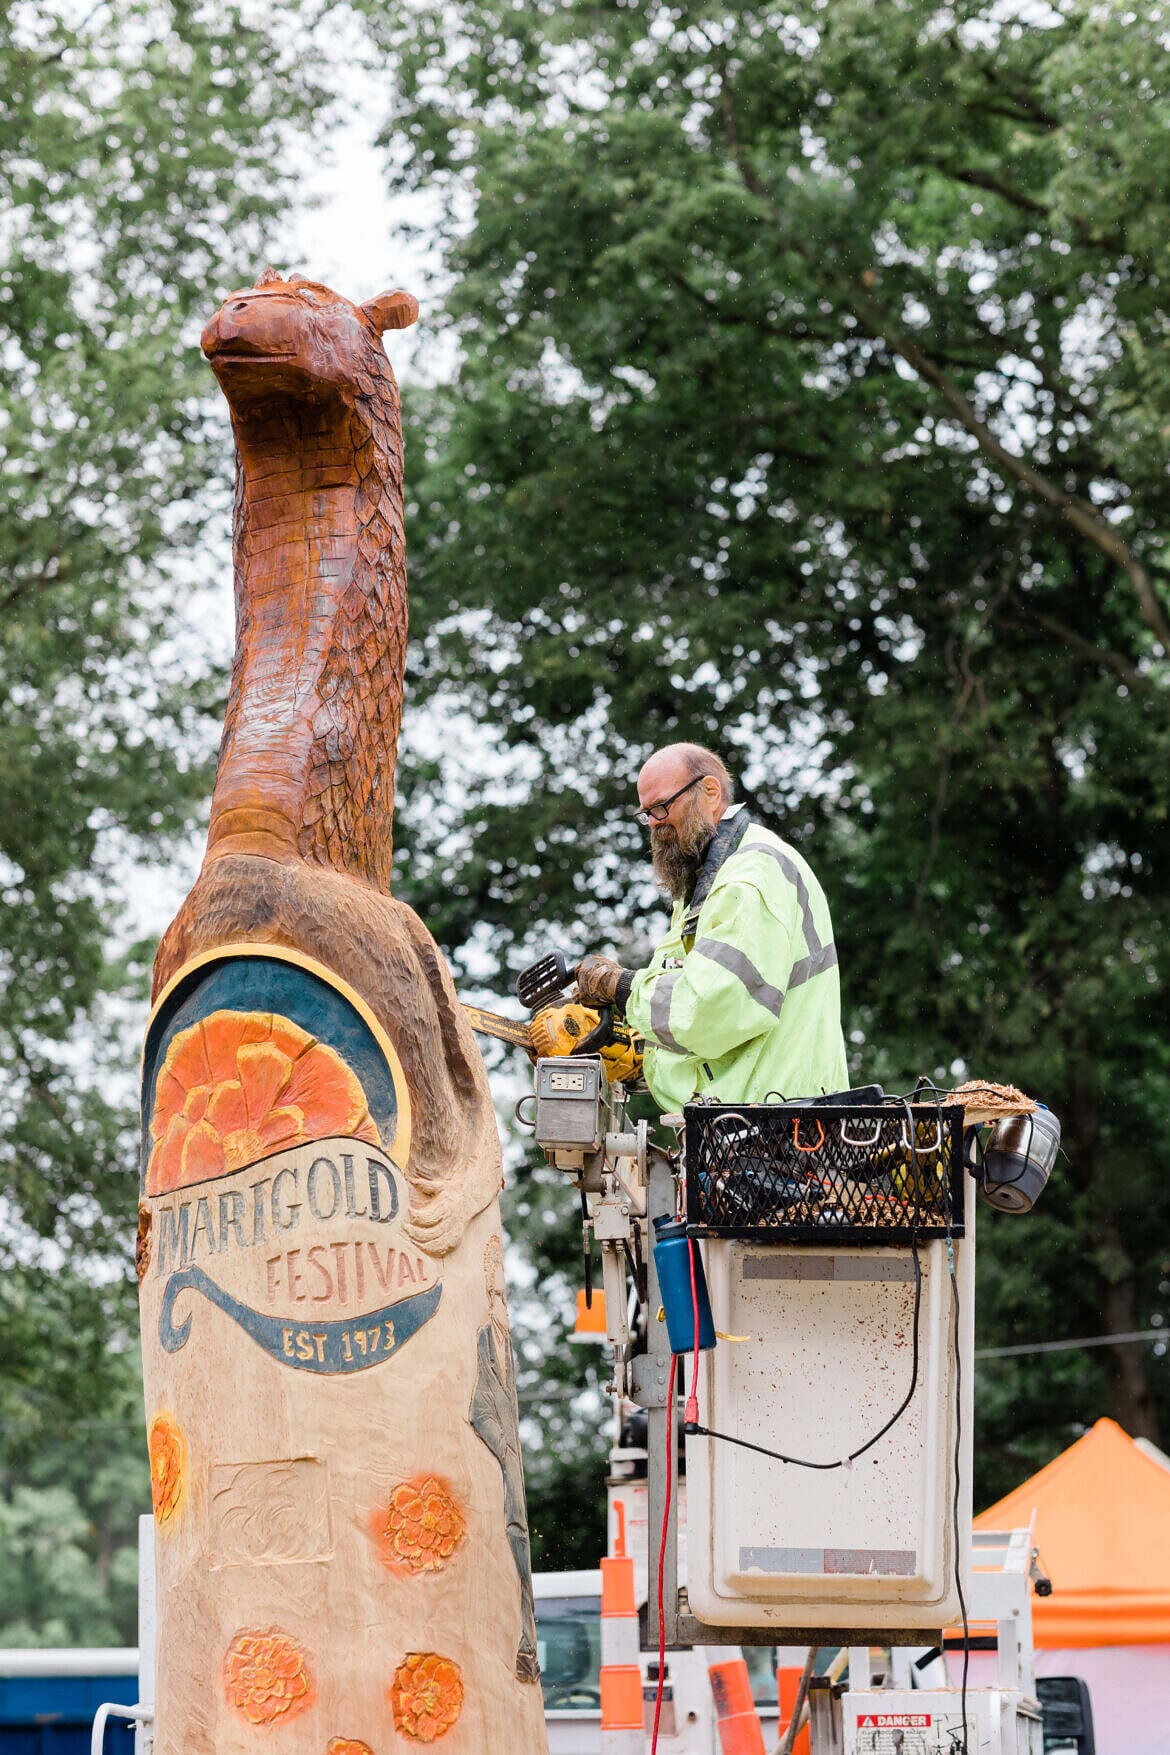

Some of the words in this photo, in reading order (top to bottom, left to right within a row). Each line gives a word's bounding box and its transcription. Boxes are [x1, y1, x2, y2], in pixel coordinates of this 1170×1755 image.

[157, 1153, 399, 1275] MARIGOLD
[266, 1241, 428, 1305] FESTIVAL
[282, 1328, 327, 1362] EST
[342, 1320, 395, 1360] 1973
[877, 1715, 927, 1726] DANGER
